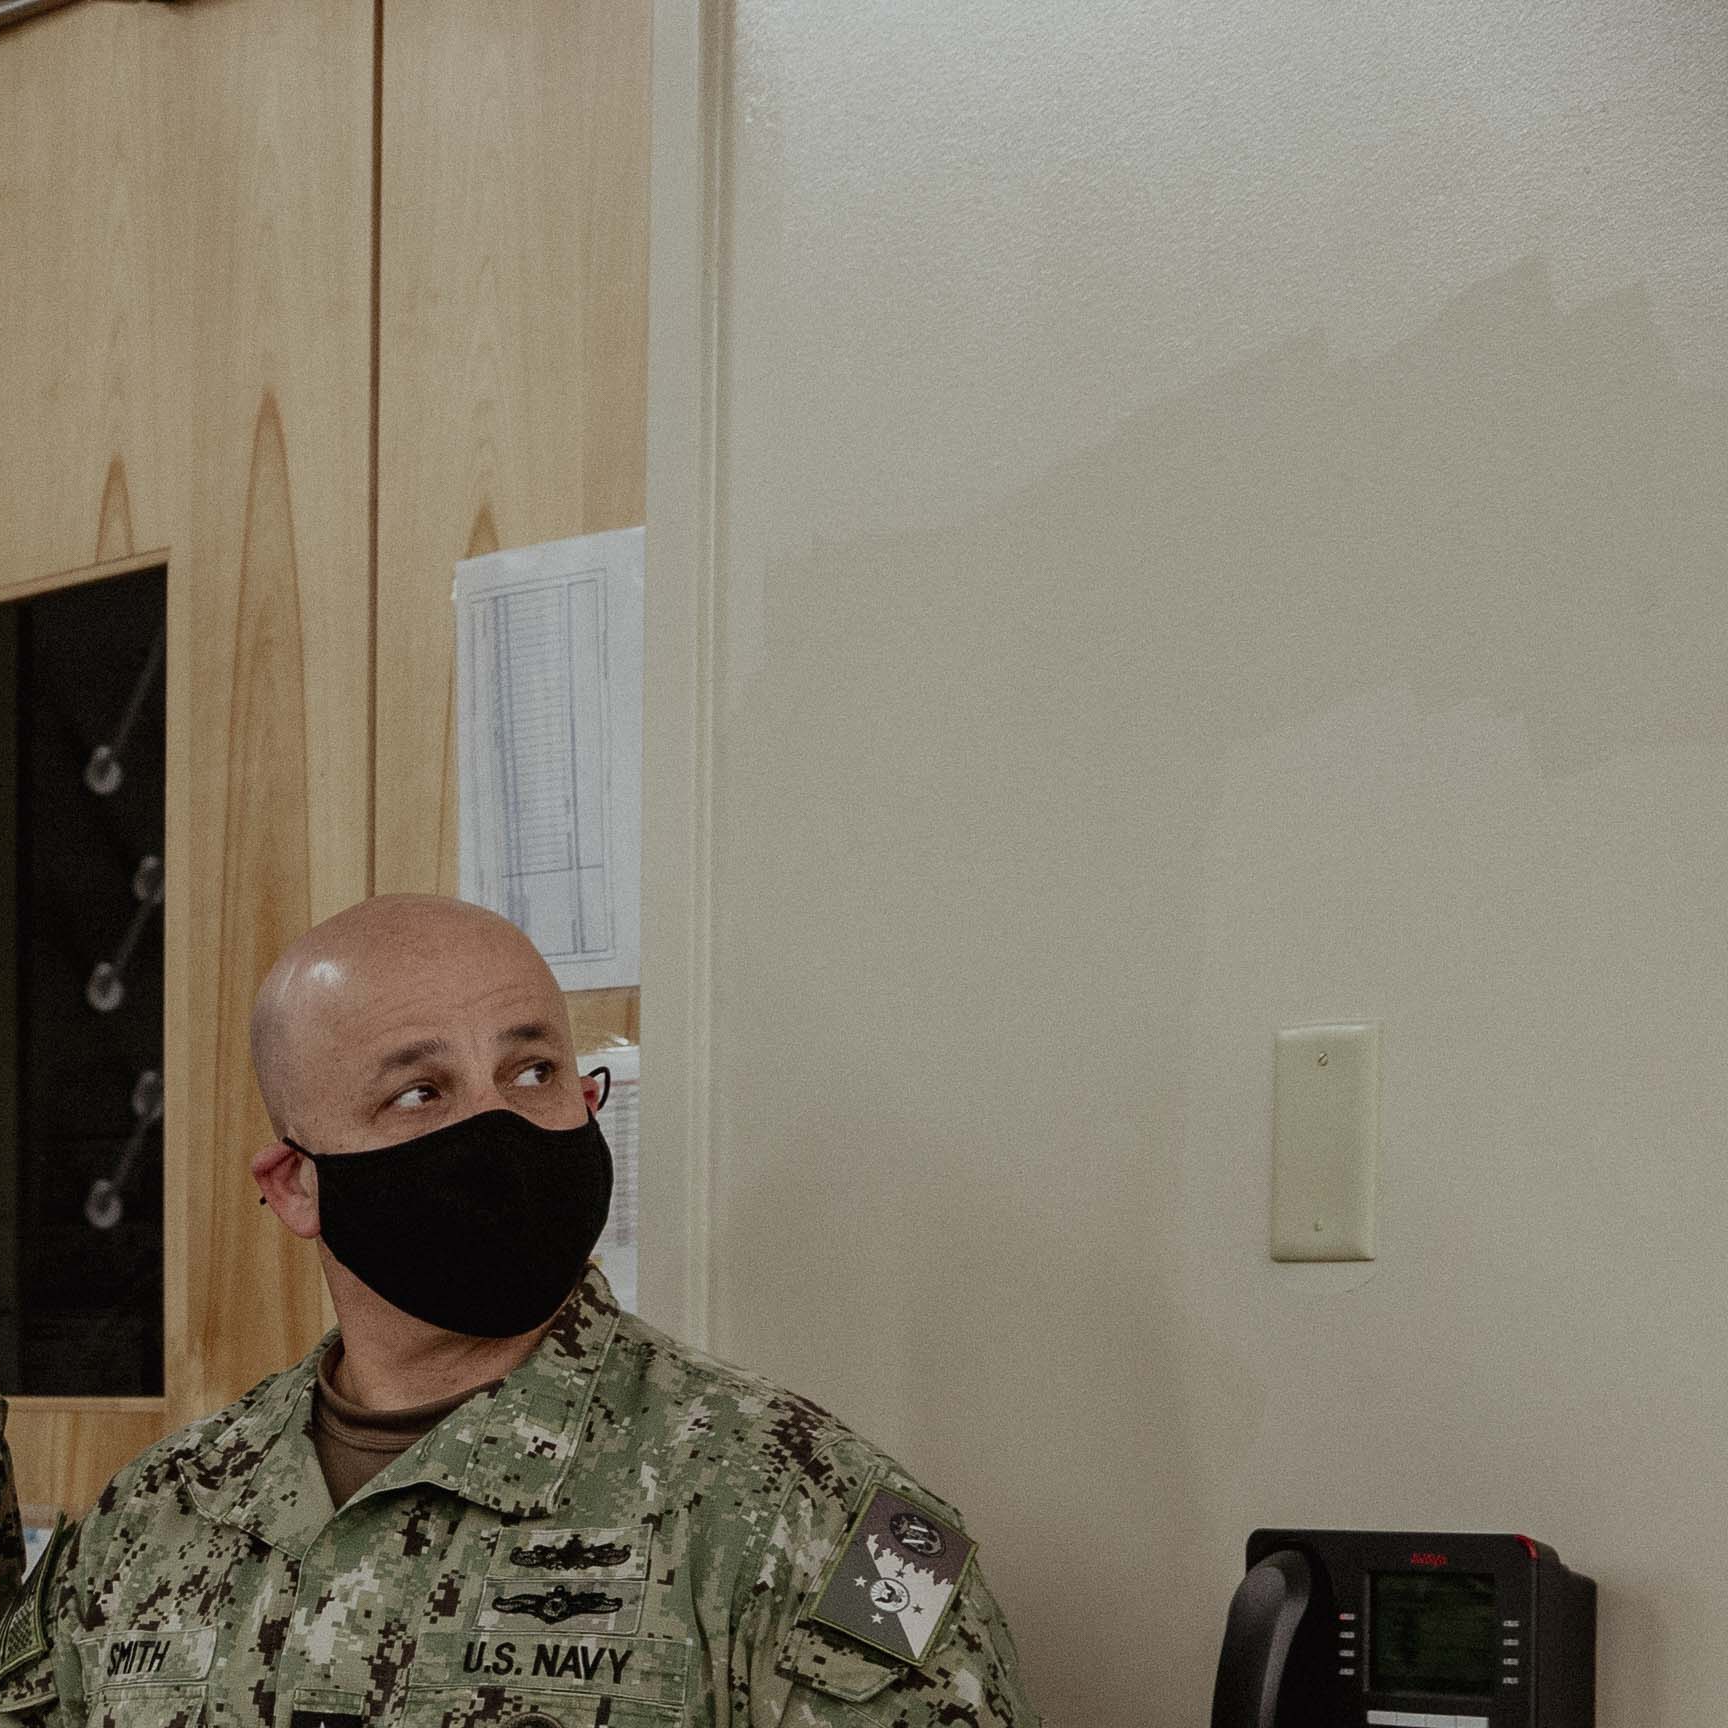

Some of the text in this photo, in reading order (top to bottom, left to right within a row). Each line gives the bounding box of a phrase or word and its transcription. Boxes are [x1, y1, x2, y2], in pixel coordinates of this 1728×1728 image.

[107, 1640, 171, 1677] SMITH
[463, 1641, 633, 1684] U.S. NAVY
